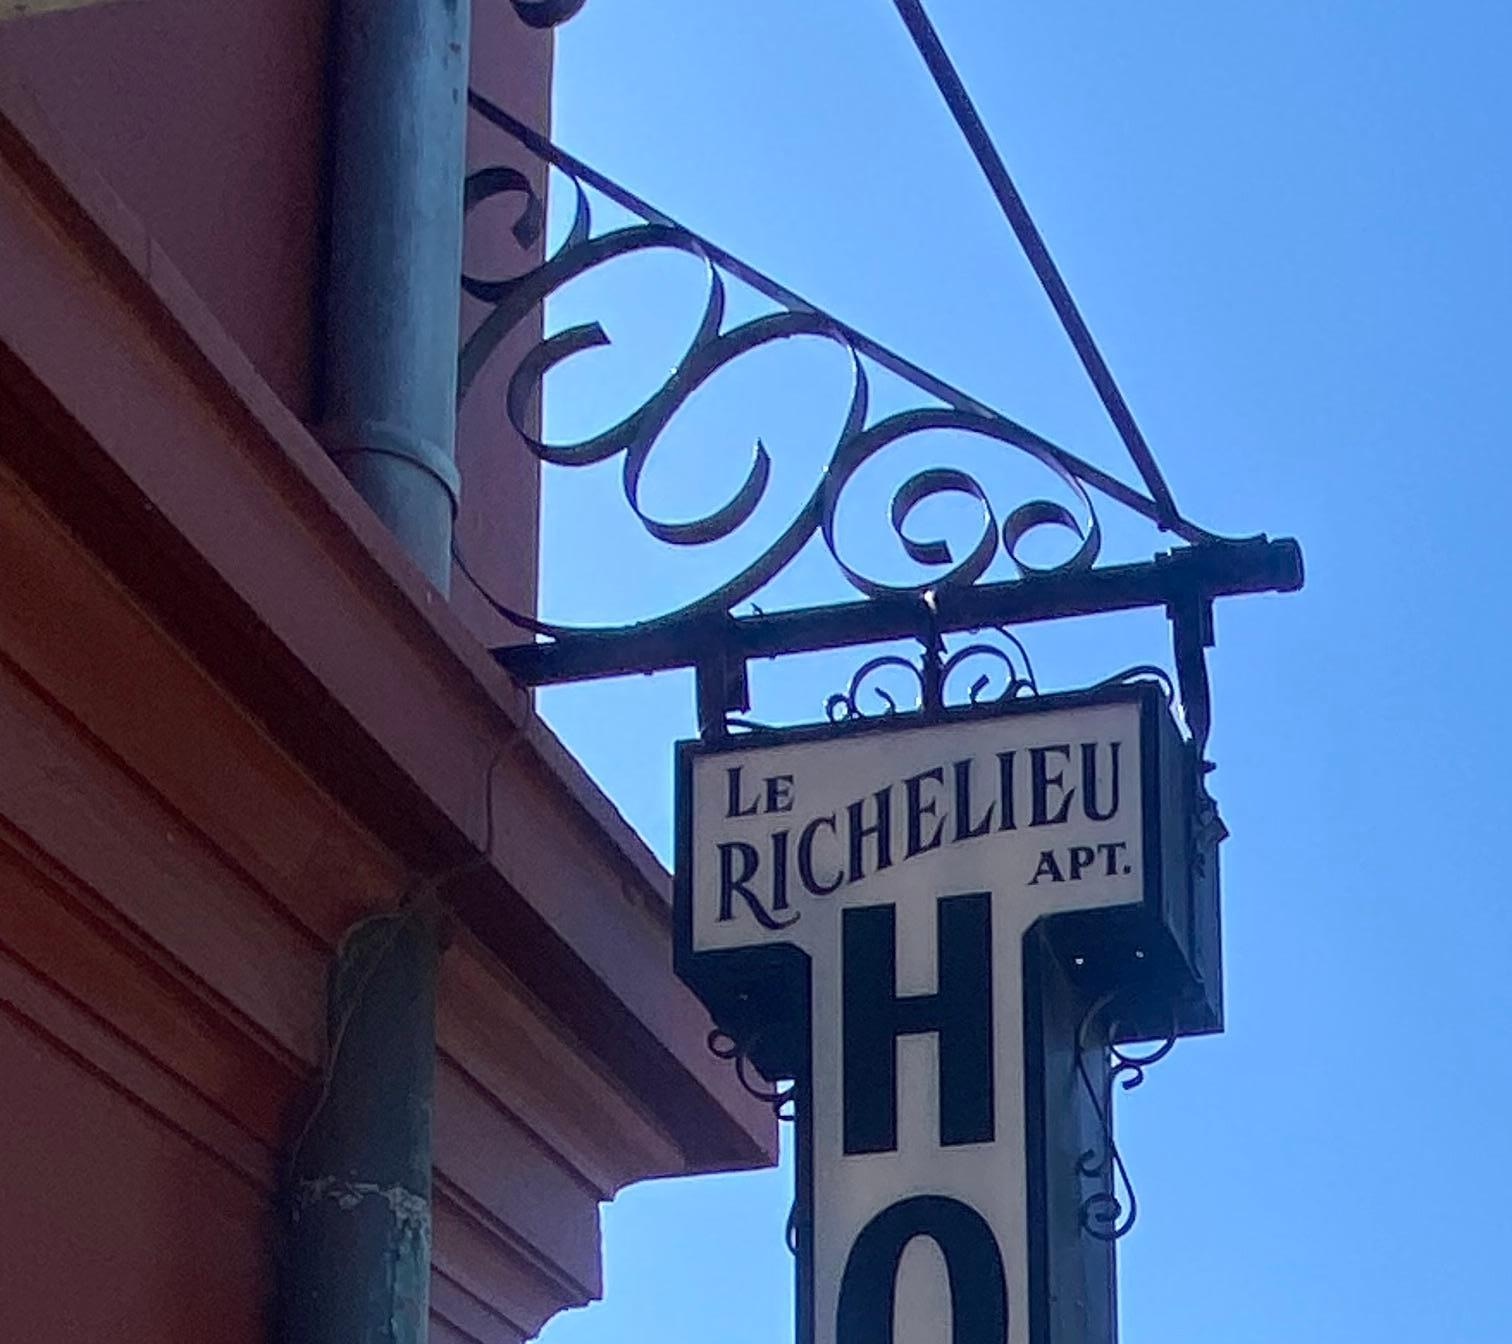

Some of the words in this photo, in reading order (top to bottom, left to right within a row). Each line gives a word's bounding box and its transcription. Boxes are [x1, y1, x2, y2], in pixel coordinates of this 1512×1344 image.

[725, 766, 795, 818] LE
[716, 741, 1122, 930] RICHELIEU
[1028, 842, 1132, 885] APT.
